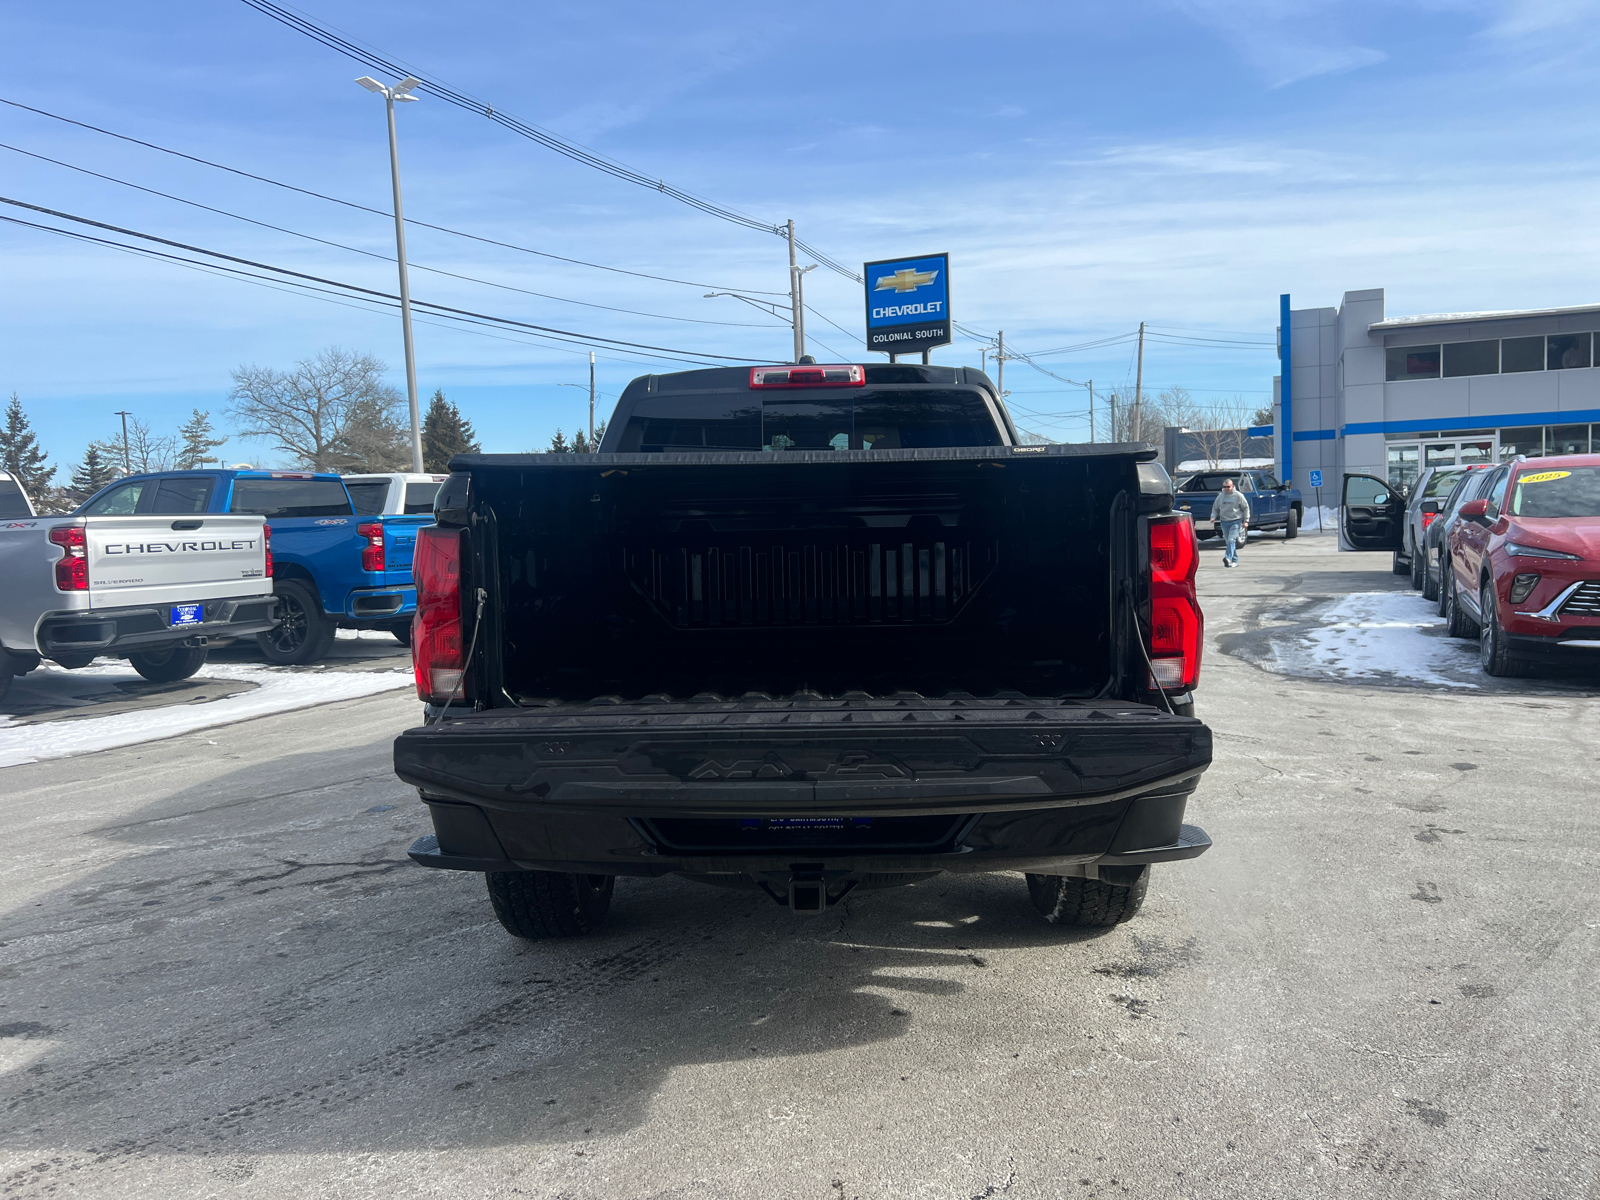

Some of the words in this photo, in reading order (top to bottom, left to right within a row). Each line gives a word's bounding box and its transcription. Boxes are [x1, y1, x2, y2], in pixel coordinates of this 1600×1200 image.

[872, 301, 943, 319] CHEVROLET
[873, 331, 913, 343] COLONIAL
[915, 328, 944, 339] SOUTH
[1527, 472, 1562, 482] 2025
[105, 540, 257, 555] CHEVROLET
